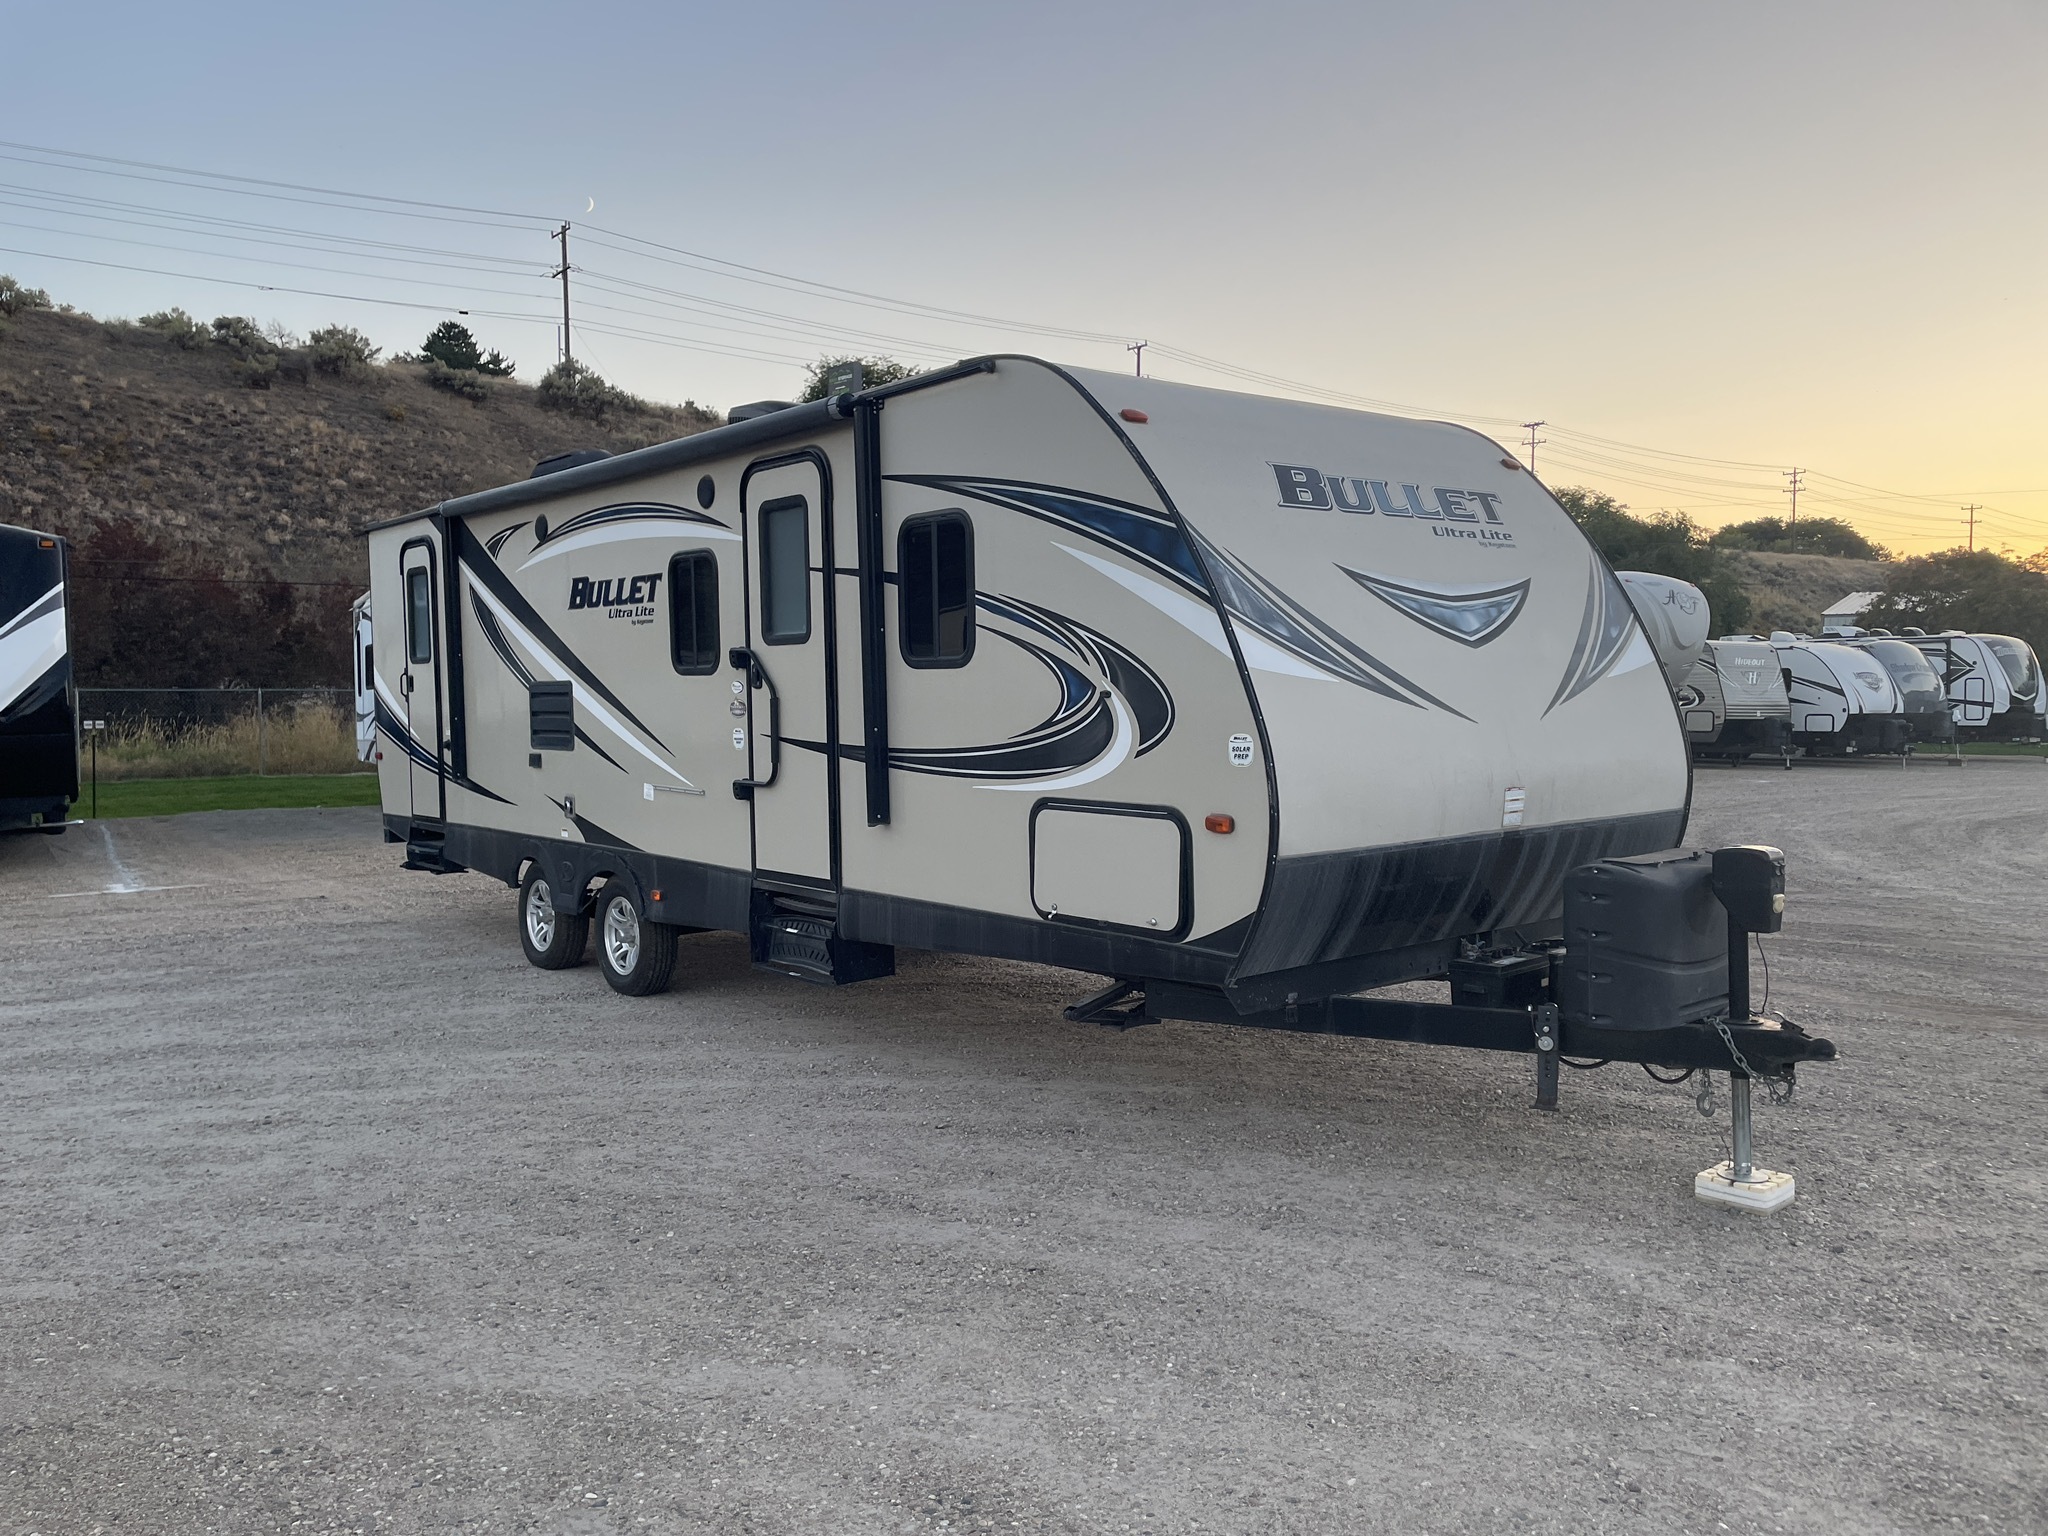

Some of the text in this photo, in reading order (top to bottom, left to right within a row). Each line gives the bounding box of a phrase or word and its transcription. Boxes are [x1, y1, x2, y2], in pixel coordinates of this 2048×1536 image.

[1265, 461, 1504, 525] BULLET
[1431, 525, 1514, 541] Ultra Lite
[567, 572, 663, 610] BULLET
[608, 606, 655, 619] Ultra Lite
[1735, 656, 1766, 666] HIDEOUT
